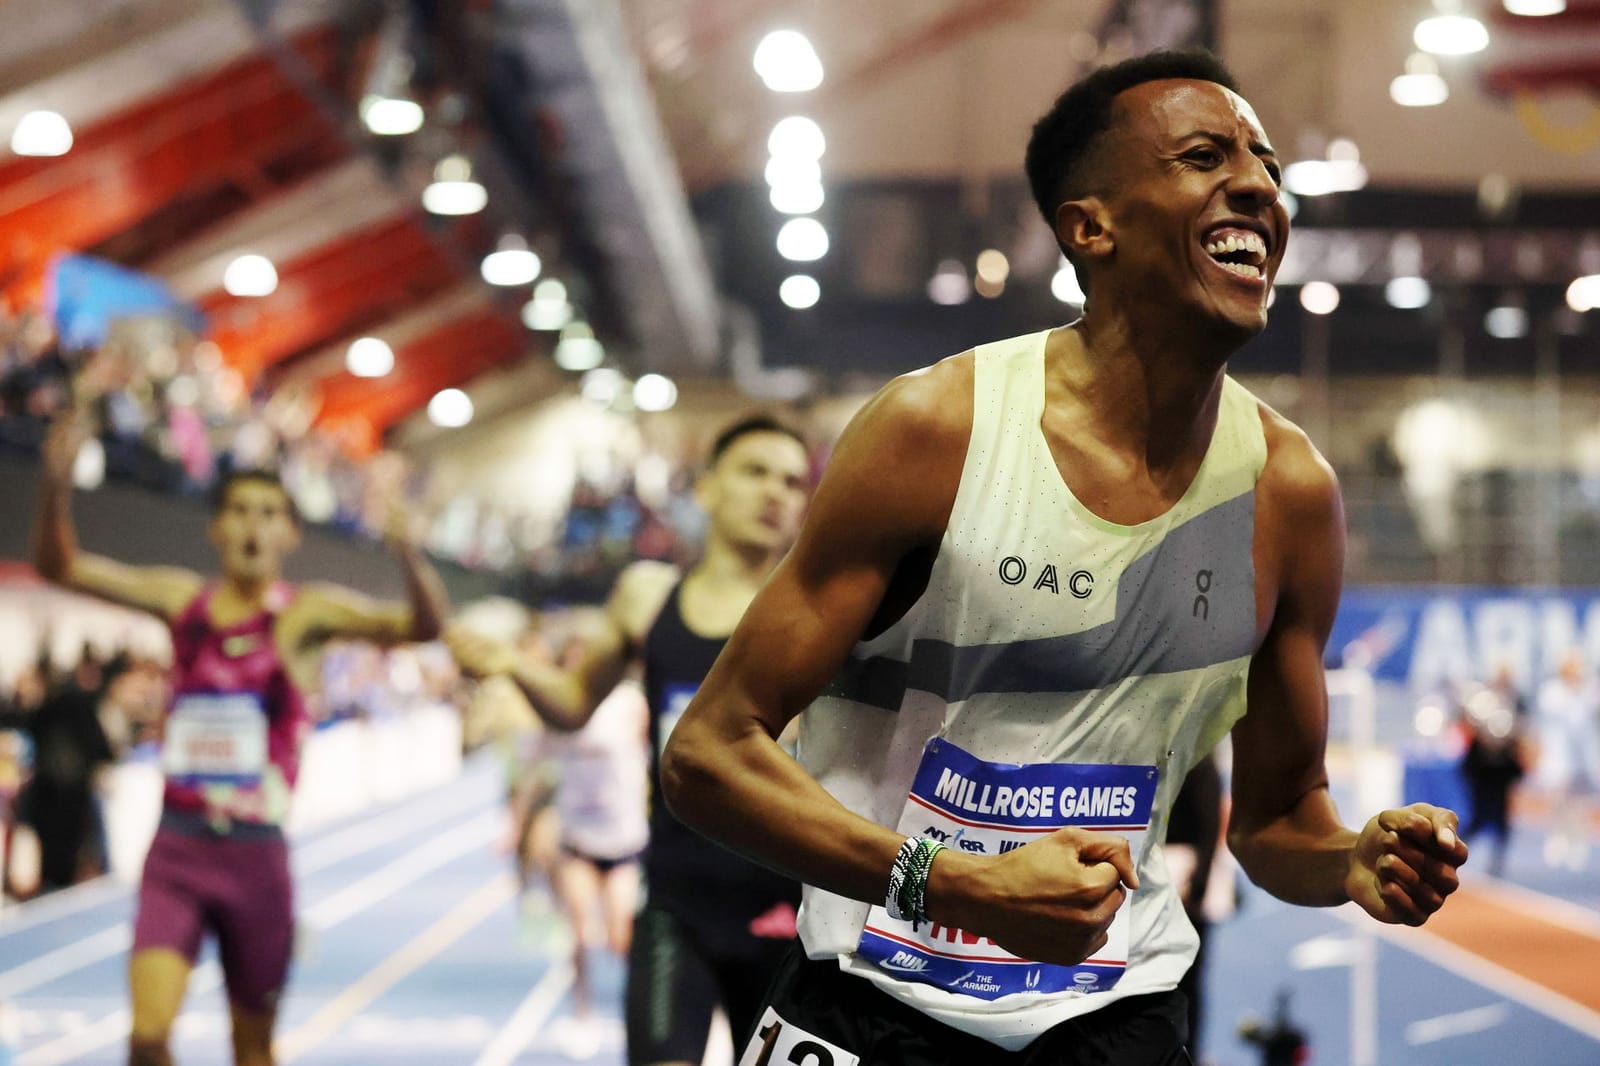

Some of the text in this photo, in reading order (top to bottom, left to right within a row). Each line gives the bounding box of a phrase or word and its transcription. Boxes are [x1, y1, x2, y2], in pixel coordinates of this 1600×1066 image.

[999, 555, 1094, 599] OAC
[934, 767, 1138, 818] MILLROSE GAMES
[890, 950, 928, 971] RUN
[962, 981, 1001, 993] ARMORY
[976, 974, 993, 984] THE
